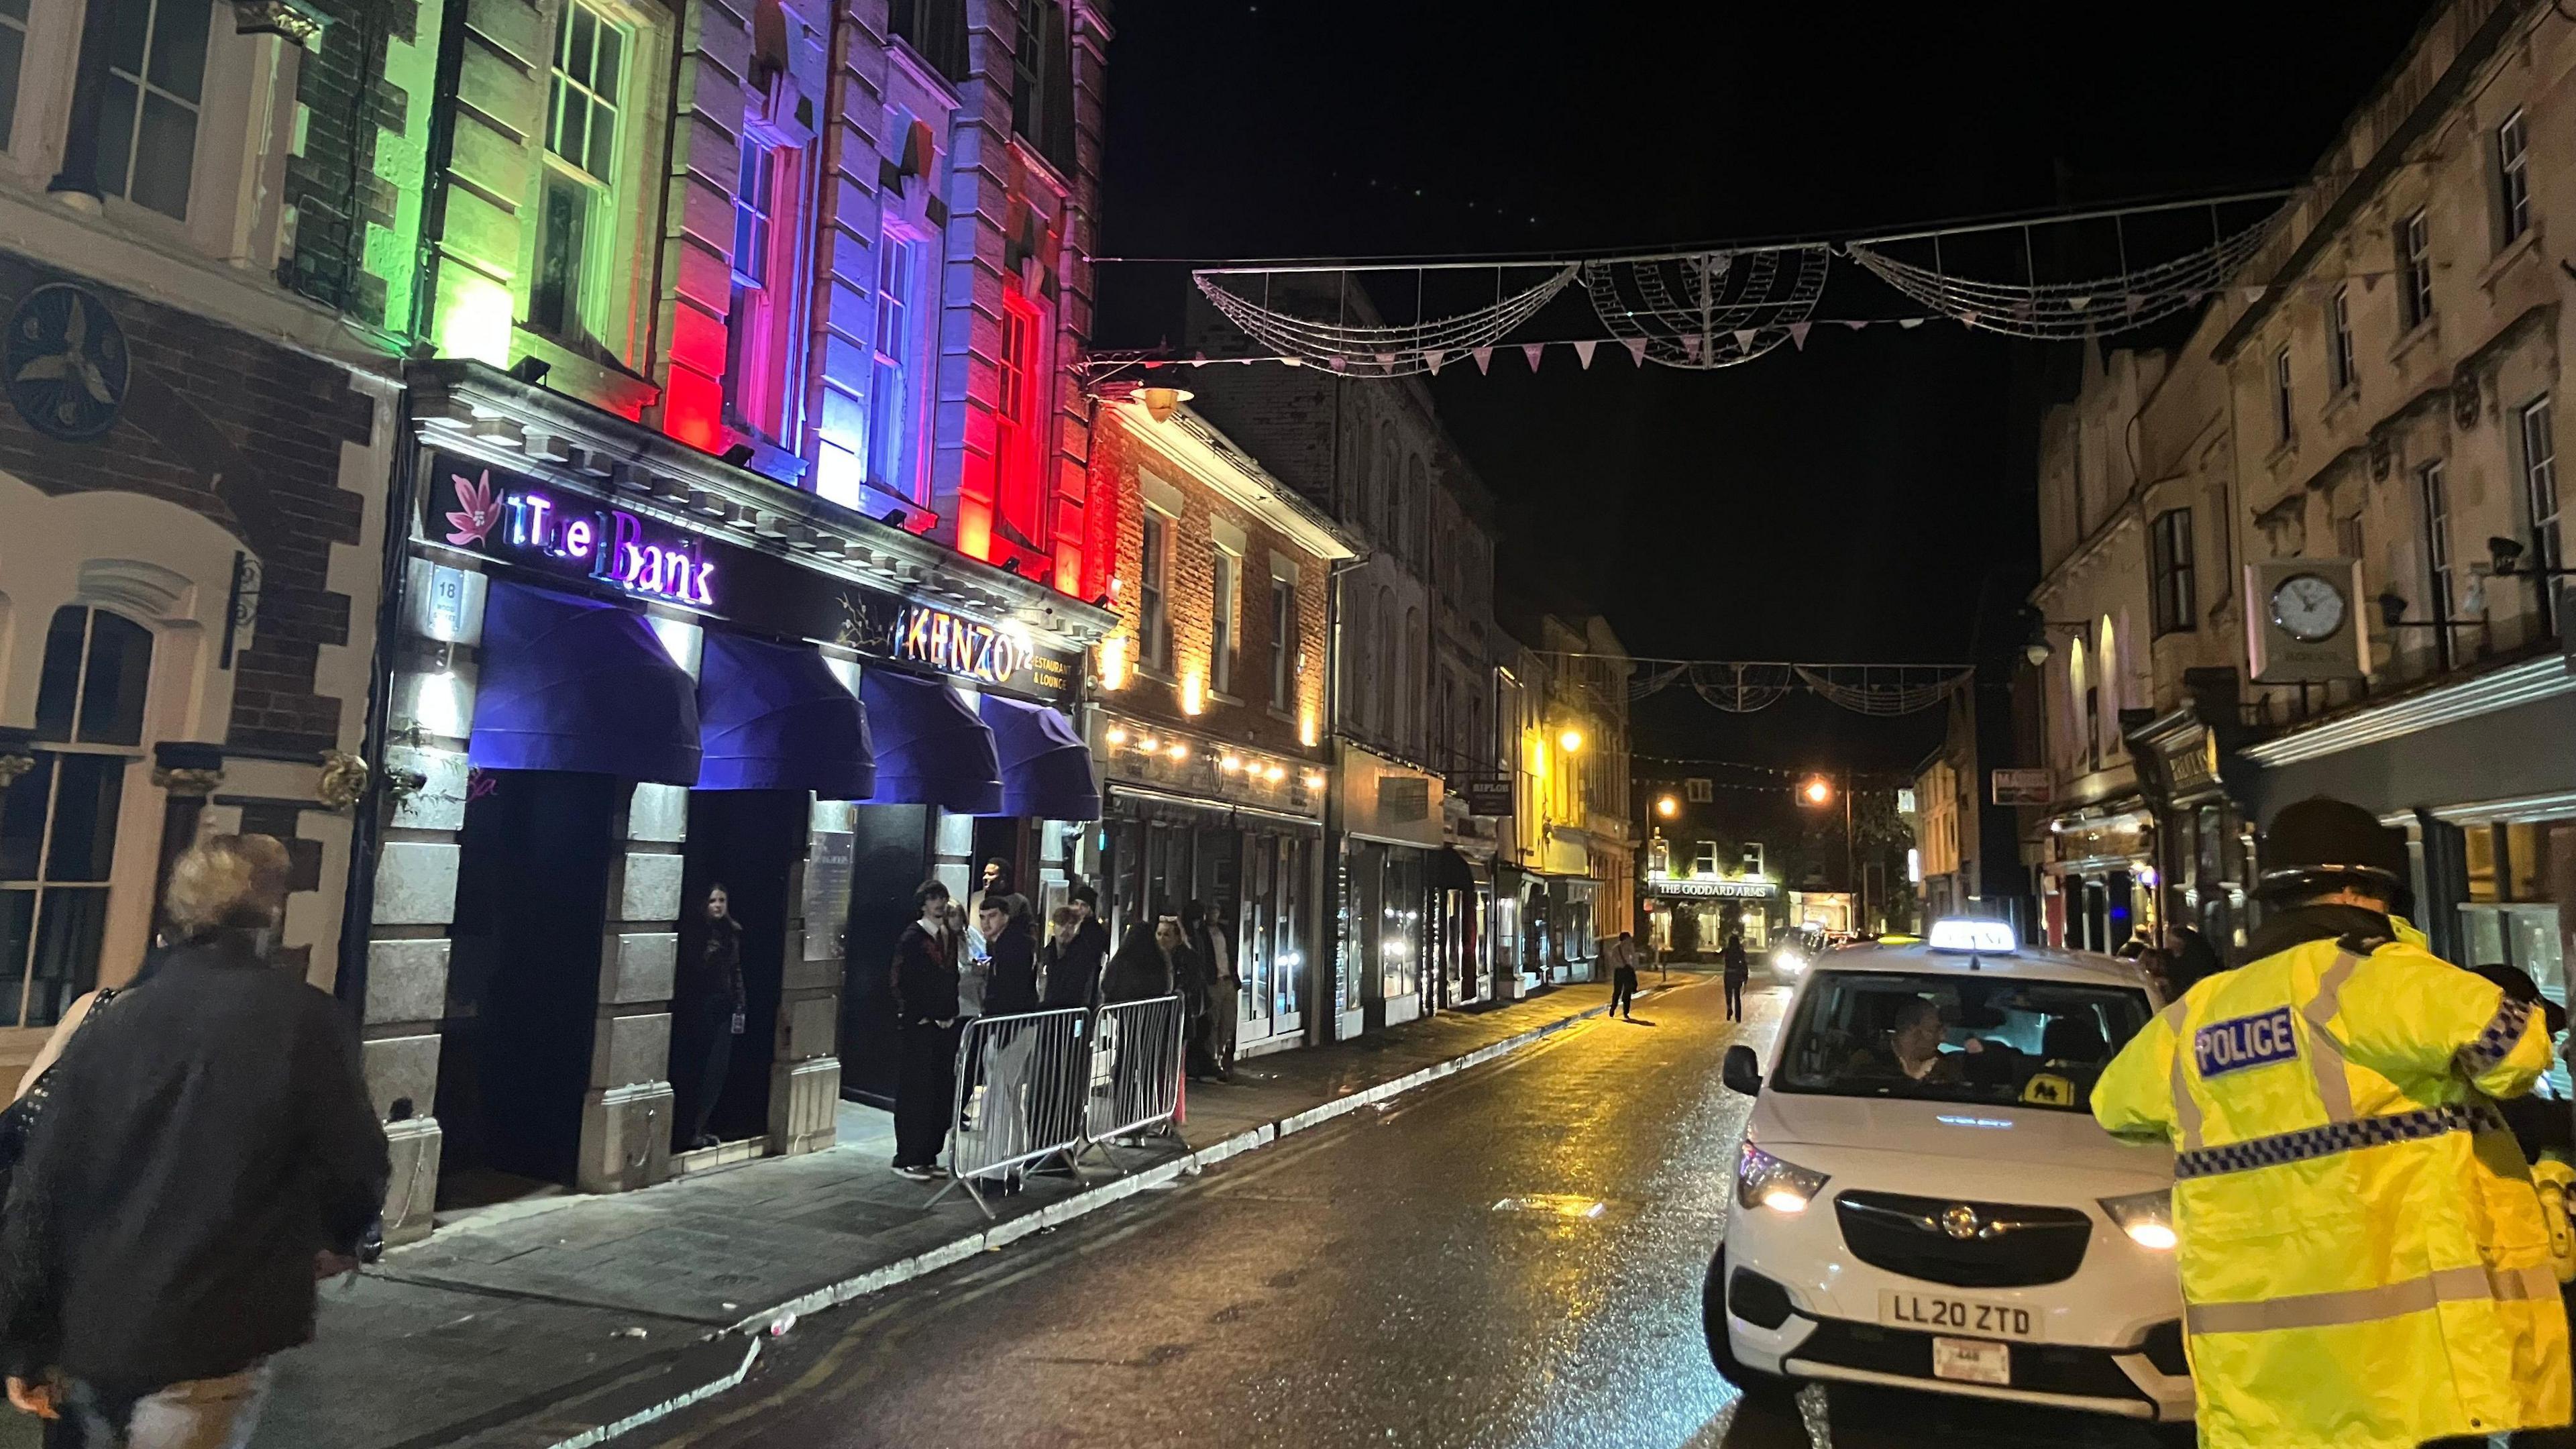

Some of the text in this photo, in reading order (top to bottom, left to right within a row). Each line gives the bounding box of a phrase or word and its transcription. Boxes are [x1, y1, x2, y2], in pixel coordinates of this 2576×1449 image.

[606, 510, 714, 605] Bank
[439, 582, 455, 598] 18
[1032, 655, 1072, 676] ESTAURANT
[1659, 883, 1766, 898] THE GODDARD ARMS
[2196, 1014, 2292, 1071] POLICE
[1894, 1295, 2029, 1334] LL20 ZTD
